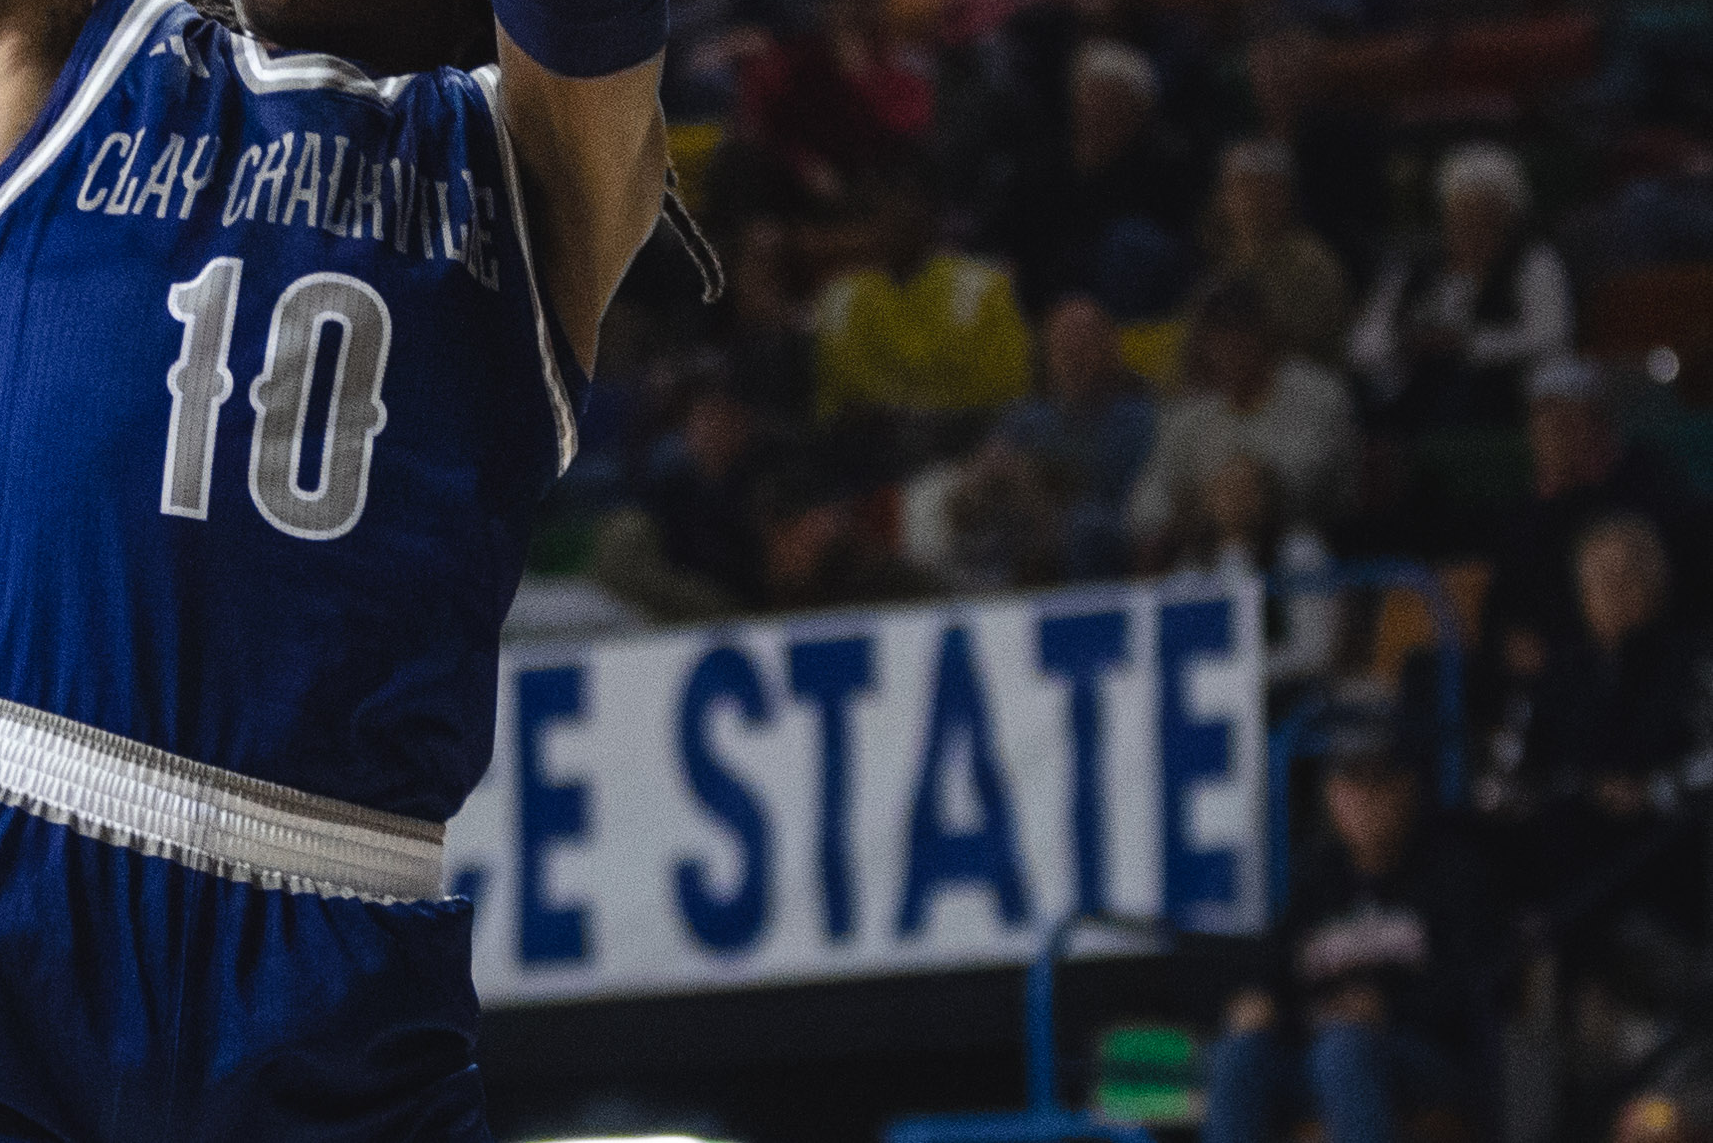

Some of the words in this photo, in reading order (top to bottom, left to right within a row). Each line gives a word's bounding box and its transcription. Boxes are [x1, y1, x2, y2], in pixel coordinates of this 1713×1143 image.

[76, 125, 222, 221] CLAY
[159, 255, 392, 541] 10
[676, 596, 1241, 956] STATE
